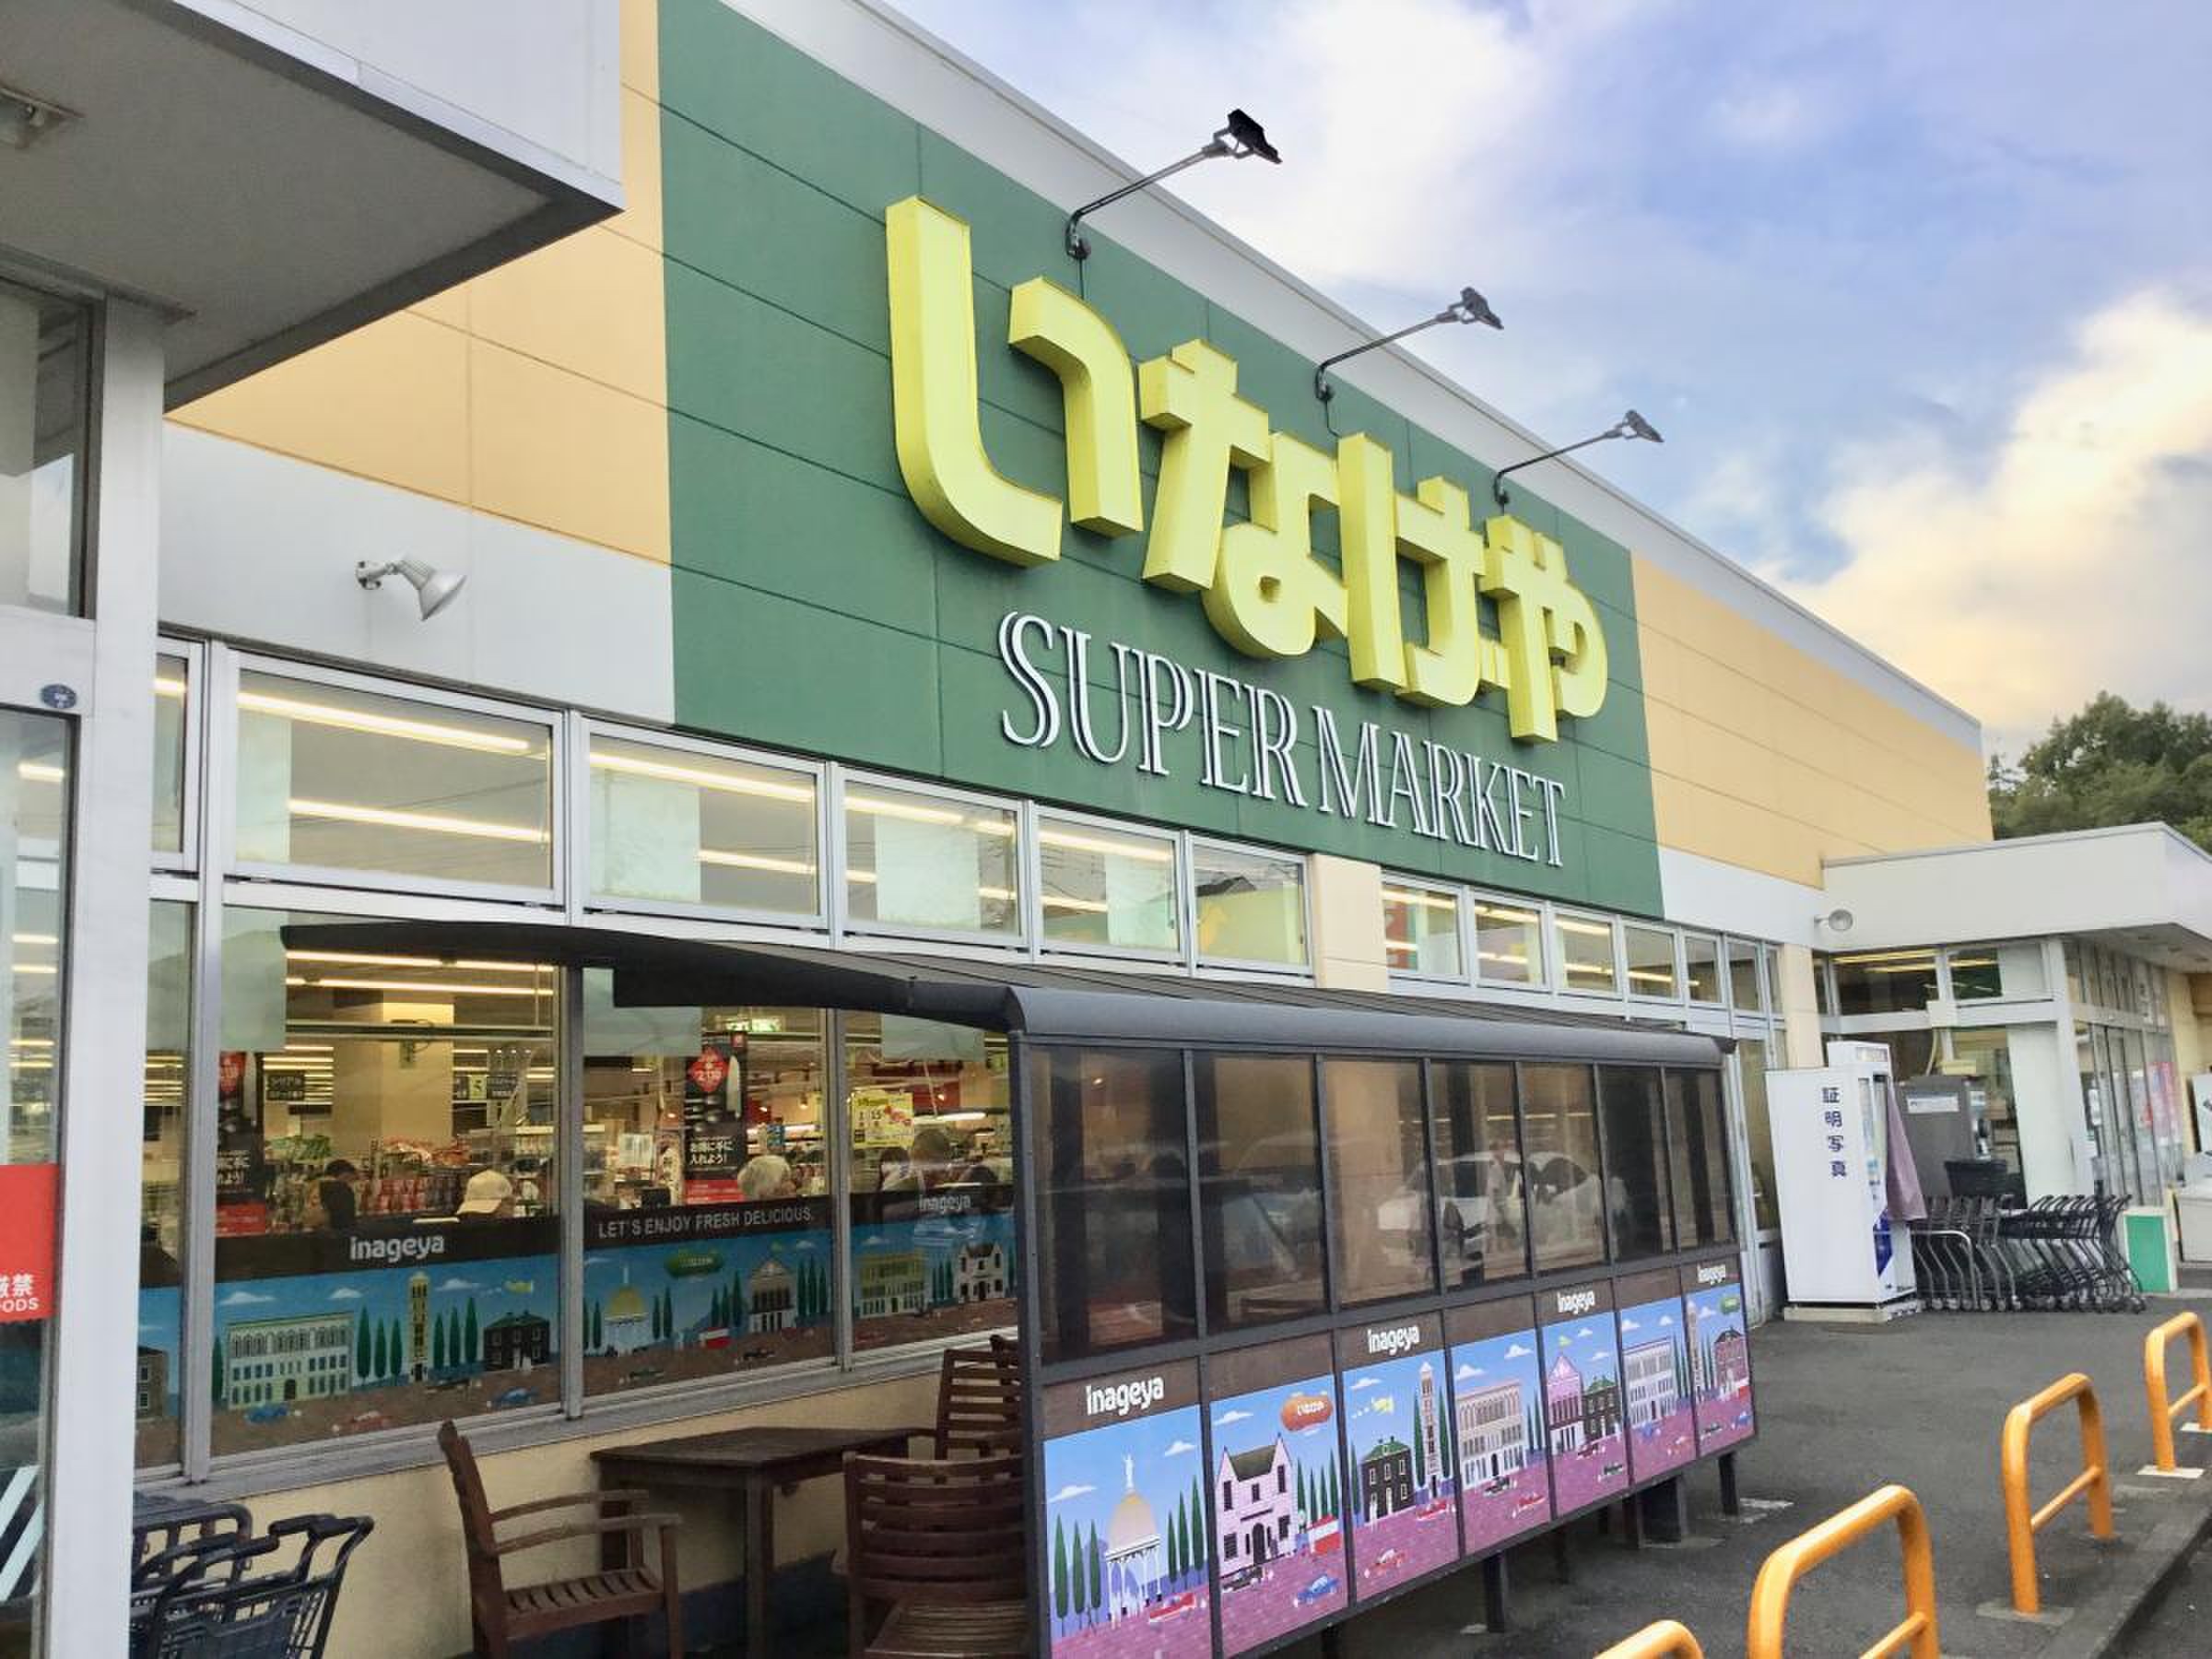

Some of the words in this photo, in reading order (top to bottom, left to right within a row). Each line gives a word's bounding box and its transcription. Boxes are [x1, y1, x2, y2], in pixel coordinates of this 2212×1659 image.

[886, 194, 1607, 744] いなげや
[998, 610, 1308, 807] SUPER
[1312, 704, 1567, 867] MARKET
[1821, 1086, 1848, 1178] 証明写真
[599, 1218, 641, 1239] LET'S
[645, 1216, 693, 1235] ENJOY
[696, 1212, 740, 1230] FRESH
[350, 1235, 444, 1264] inageya
[0, 1297, 40, 1313] ODS
[1557, 1290, 1595, 1314] inageya
[1367, 1324, 1420, 1355] inageya
[1086, 1377, 1164, 1417] inageya
